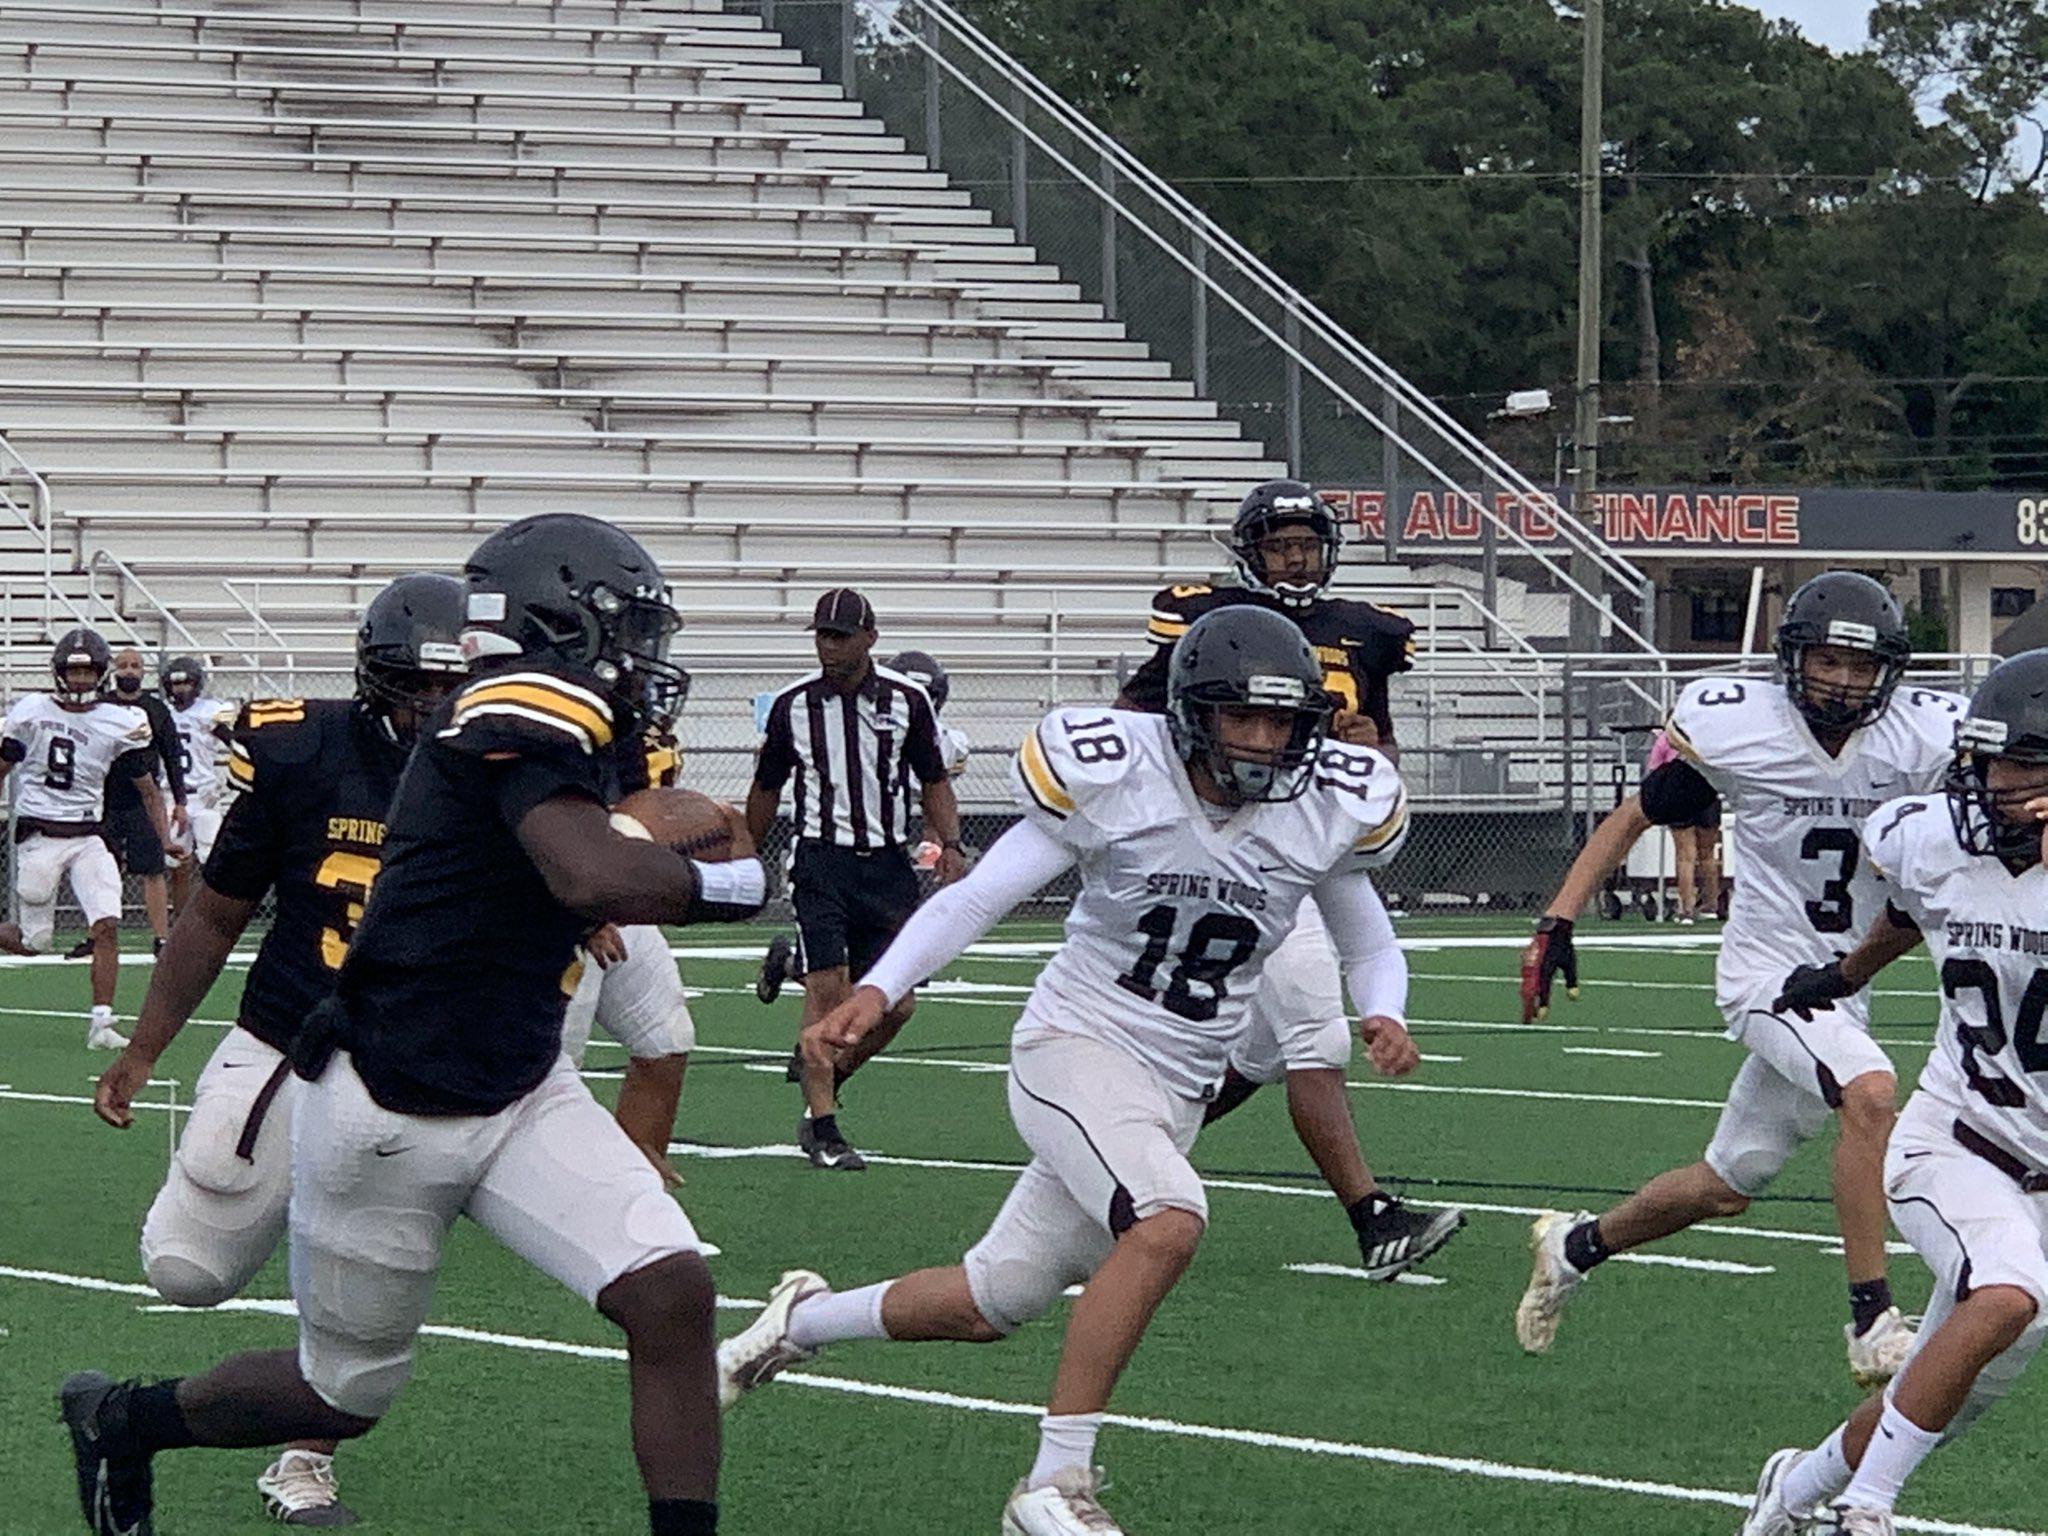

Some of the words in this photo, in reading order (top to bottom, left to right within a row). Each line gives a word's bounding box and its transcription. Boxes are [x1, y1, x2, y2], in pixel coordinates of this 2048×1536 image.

[1403, 491, 1558, 541] AUTO
[1592, 493, 1800, 544] INANCE
[1061, 715, 1128, 765] 18
[1316, 750, 1376, 802] 18
[1783, 797, 1834, 816] SPRING
[1146, 873, 1211, 899] SPRING
[1800, 827, 1860, 934] 3
[1946, 922, 2003, 948] SPRING
[1115, 905, 1260, 1022] 18
